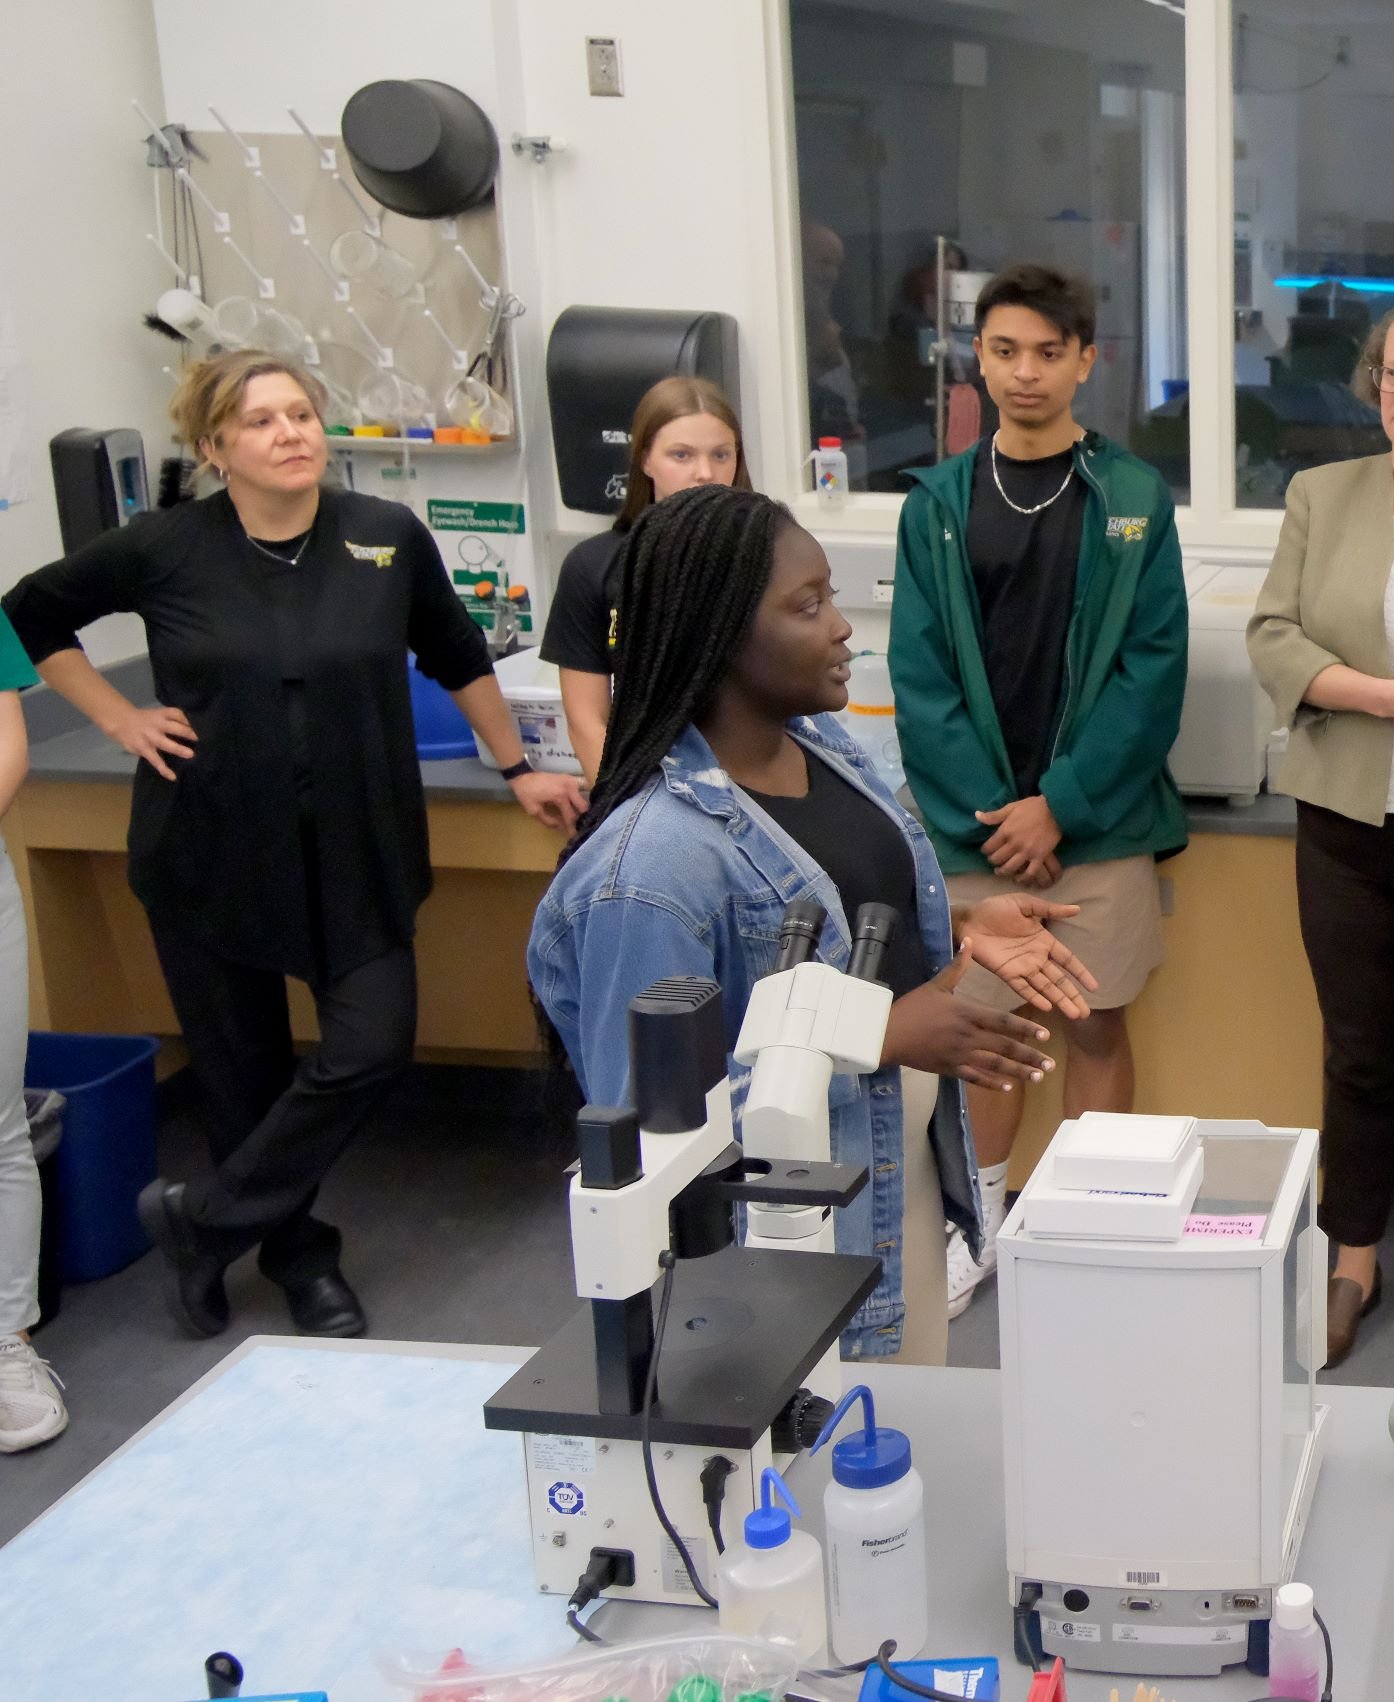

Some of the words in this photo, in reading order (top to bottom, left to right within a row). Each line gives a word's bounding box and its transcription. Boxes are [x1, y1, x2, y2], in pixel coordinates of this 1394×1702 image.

[431, 504, 475, 517] Emergency
[1195, 1219, 1211, 1227] Do
[1217, 1220, 1253, 1228] Please
[861, 1527, 909, 1547] Fisherbrand
